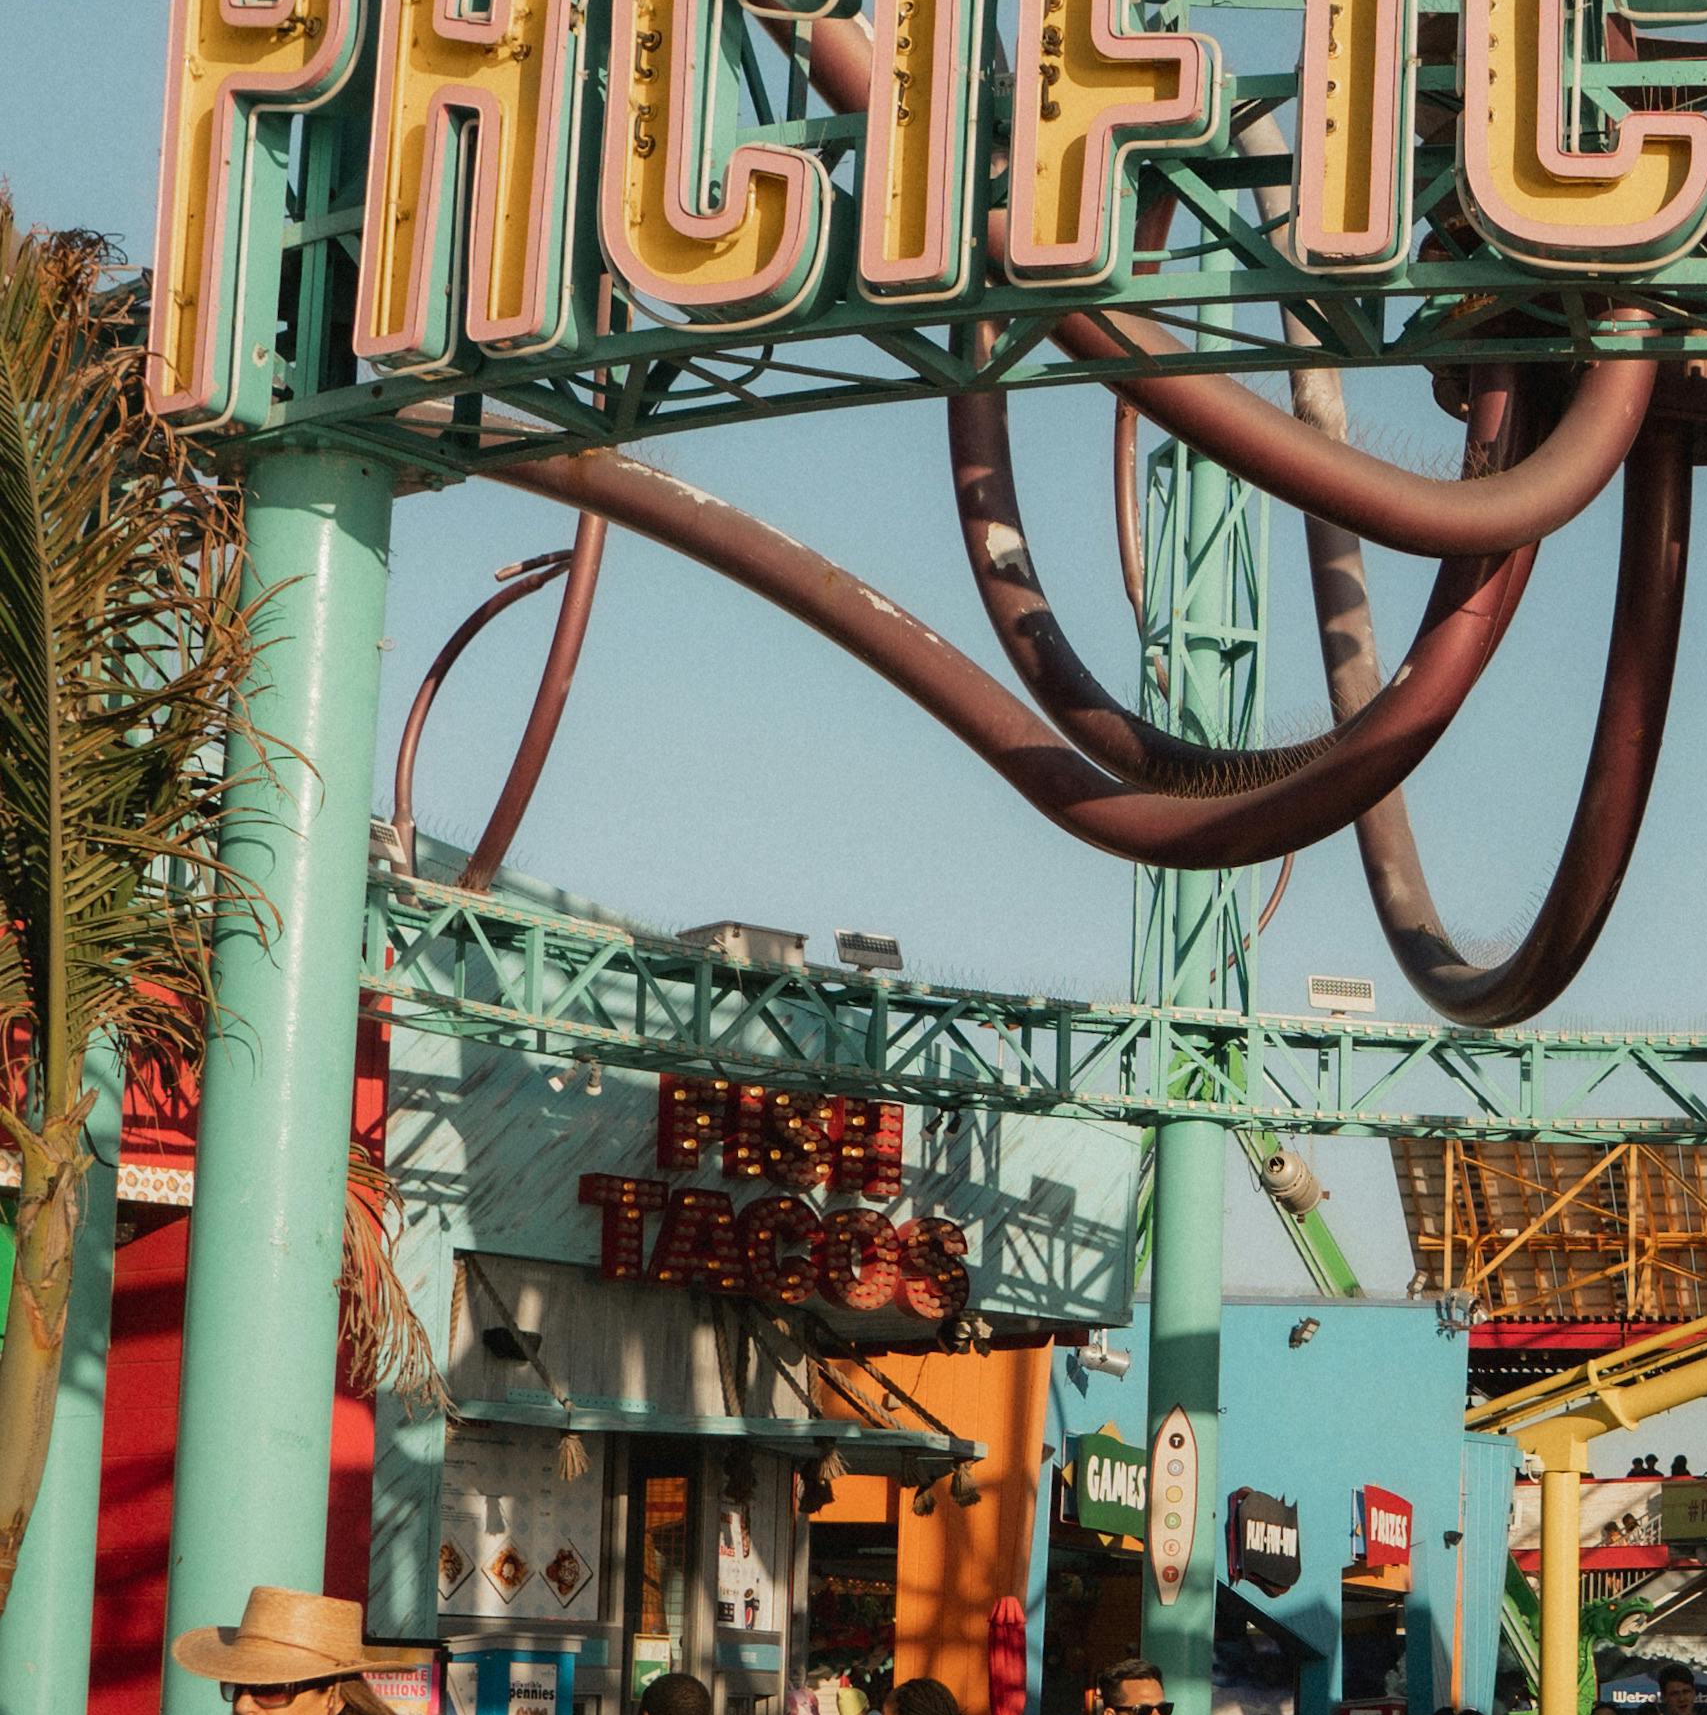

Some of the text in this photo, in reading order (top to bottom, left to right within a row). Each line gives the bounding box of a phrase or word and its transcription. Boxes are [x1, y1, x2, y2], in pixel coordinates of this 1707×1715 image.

[657, 1072, 905, 1202] FISH
[578, 1173, 970, 1320] TACOS
[1086, 1455, 1147, 1511] GAMES
[1370, 1506, 1408, 1550] PRIZES
[372, 1684, 428, 1698] ALLIONS
[508, 1686, 555, 1703] pennies
[1612, 1690, 1662, 1704] Wetzel
